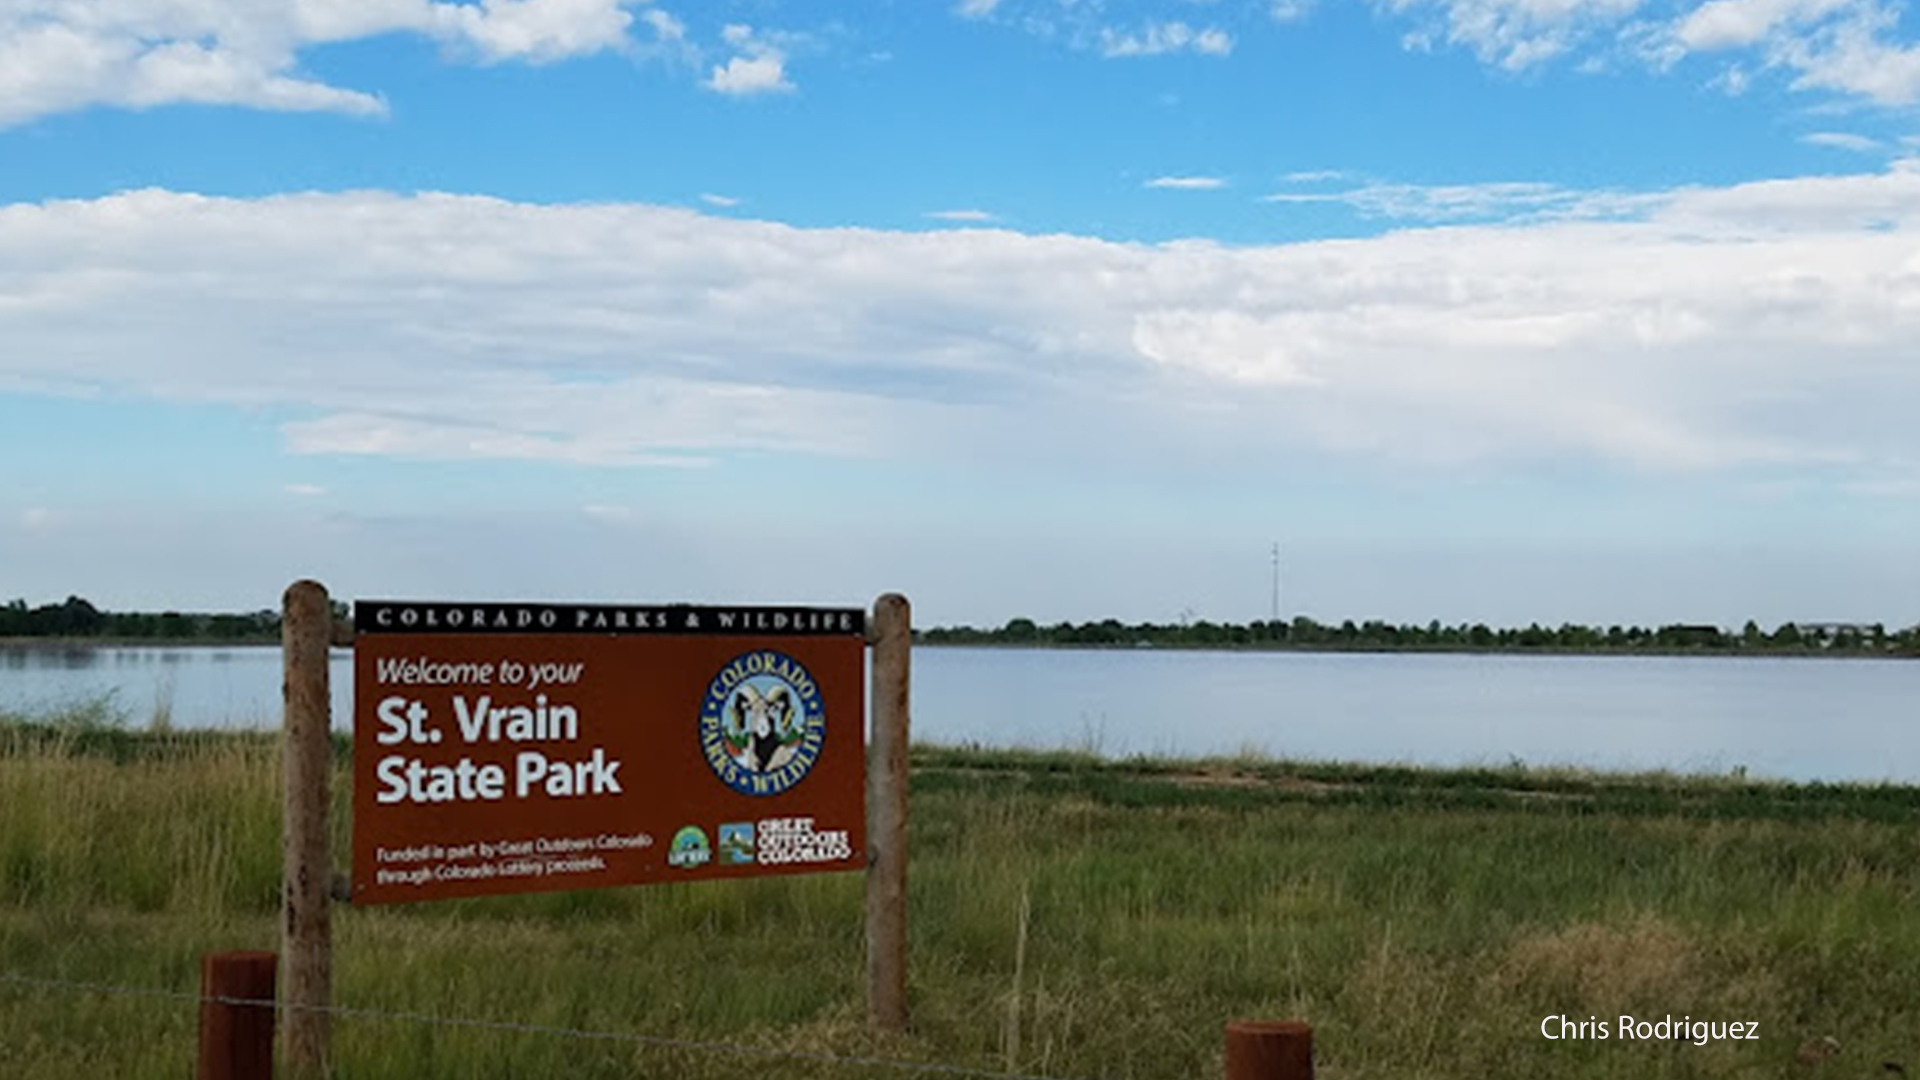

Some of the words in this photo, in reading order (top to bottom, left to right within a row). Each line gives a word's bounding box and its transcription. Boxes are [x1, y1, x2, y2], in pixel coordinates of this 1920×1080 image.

[377, 607, 557, 628] COLORADO
[575, 610, 667, 629] PARKS
[684, 611, 700, 629] &
[717, 612, 852, 630] WILDLIFE
[376, 656, 494, 684] Welcome
[499, 660, 525, 684] to
[526, 662, 584, 690] your
[711, 653, 816, 700] COLORADO
[376, 696, 443, 745] St.
[453, 694, 578, 743] Vrain
[702, 716, 738, 783] PARKS
[751, 716, 824, 793] WILDLIFE
[376, 755, 506, 803] State
[516, 748, 622, 798] Park
[757, 817, 815, 834] GREAT
[757, 830, 849, 850] OUTDOORS
[377, 844, 430, 862] Funded
[433, 844, 445, 860] in
[448, 844, 476, 861] part
[480, 842, 495, 858] by
[499, 841, 534, 856] Great
[535, 838, 595, 854] Outdoors
[597, 834, 652, 850] Colorado
[757, 846, 852, 865] COLORADO
[376, 866, 433, 885] through
[435, 864, 494, 880] Colorado
